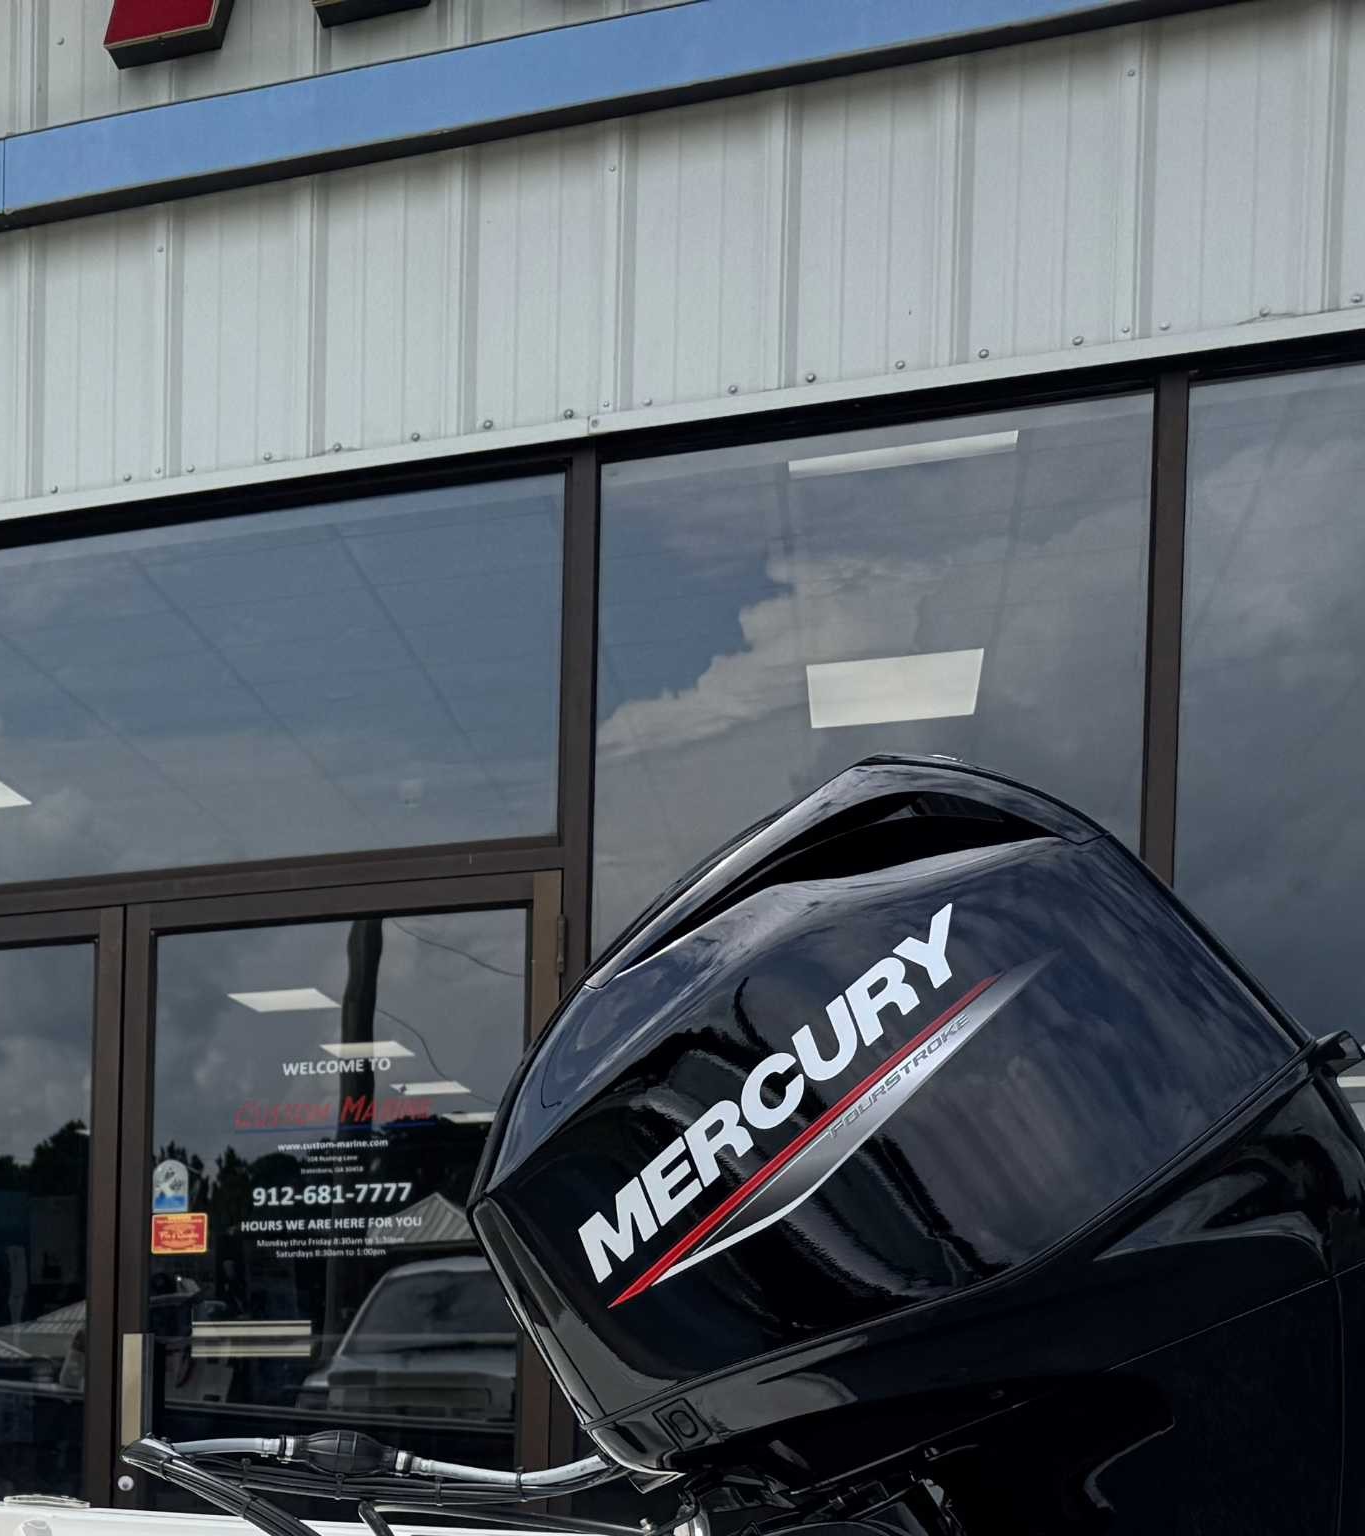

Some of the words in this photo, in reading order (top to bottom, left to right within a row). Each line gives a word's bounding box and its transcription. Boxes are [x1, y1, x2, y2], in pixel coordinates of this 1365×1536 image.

[282, 1059, 365, 1076] WELCOME
[370, 1057, 392, 1071] TO
[830, 1013, 971, 1138] FOURSTROKE
[577, 902, 954, 1283] MERCURY
[277, 1139, 389, 1153] www.custom-marine.com
[252, 1182, 413, 1207] 912-681-7777
[240, 1220, 283, 1232] HOURS
[285, 1220, 305, 1230] WE
[307, 1219, 331, 1230] ARE
[334, 1218, 365, 1229] HERE
[368, 1217, 393, 1228] FOR
[395, 1216, 422, 1227] YOU
[257, 1238, 289, 1249] Monday
[290, 1237, 307, 1247] thru
[308, 1237, 332, 1248] Friday
[276, 1249, 314, 1260] Saturdays
